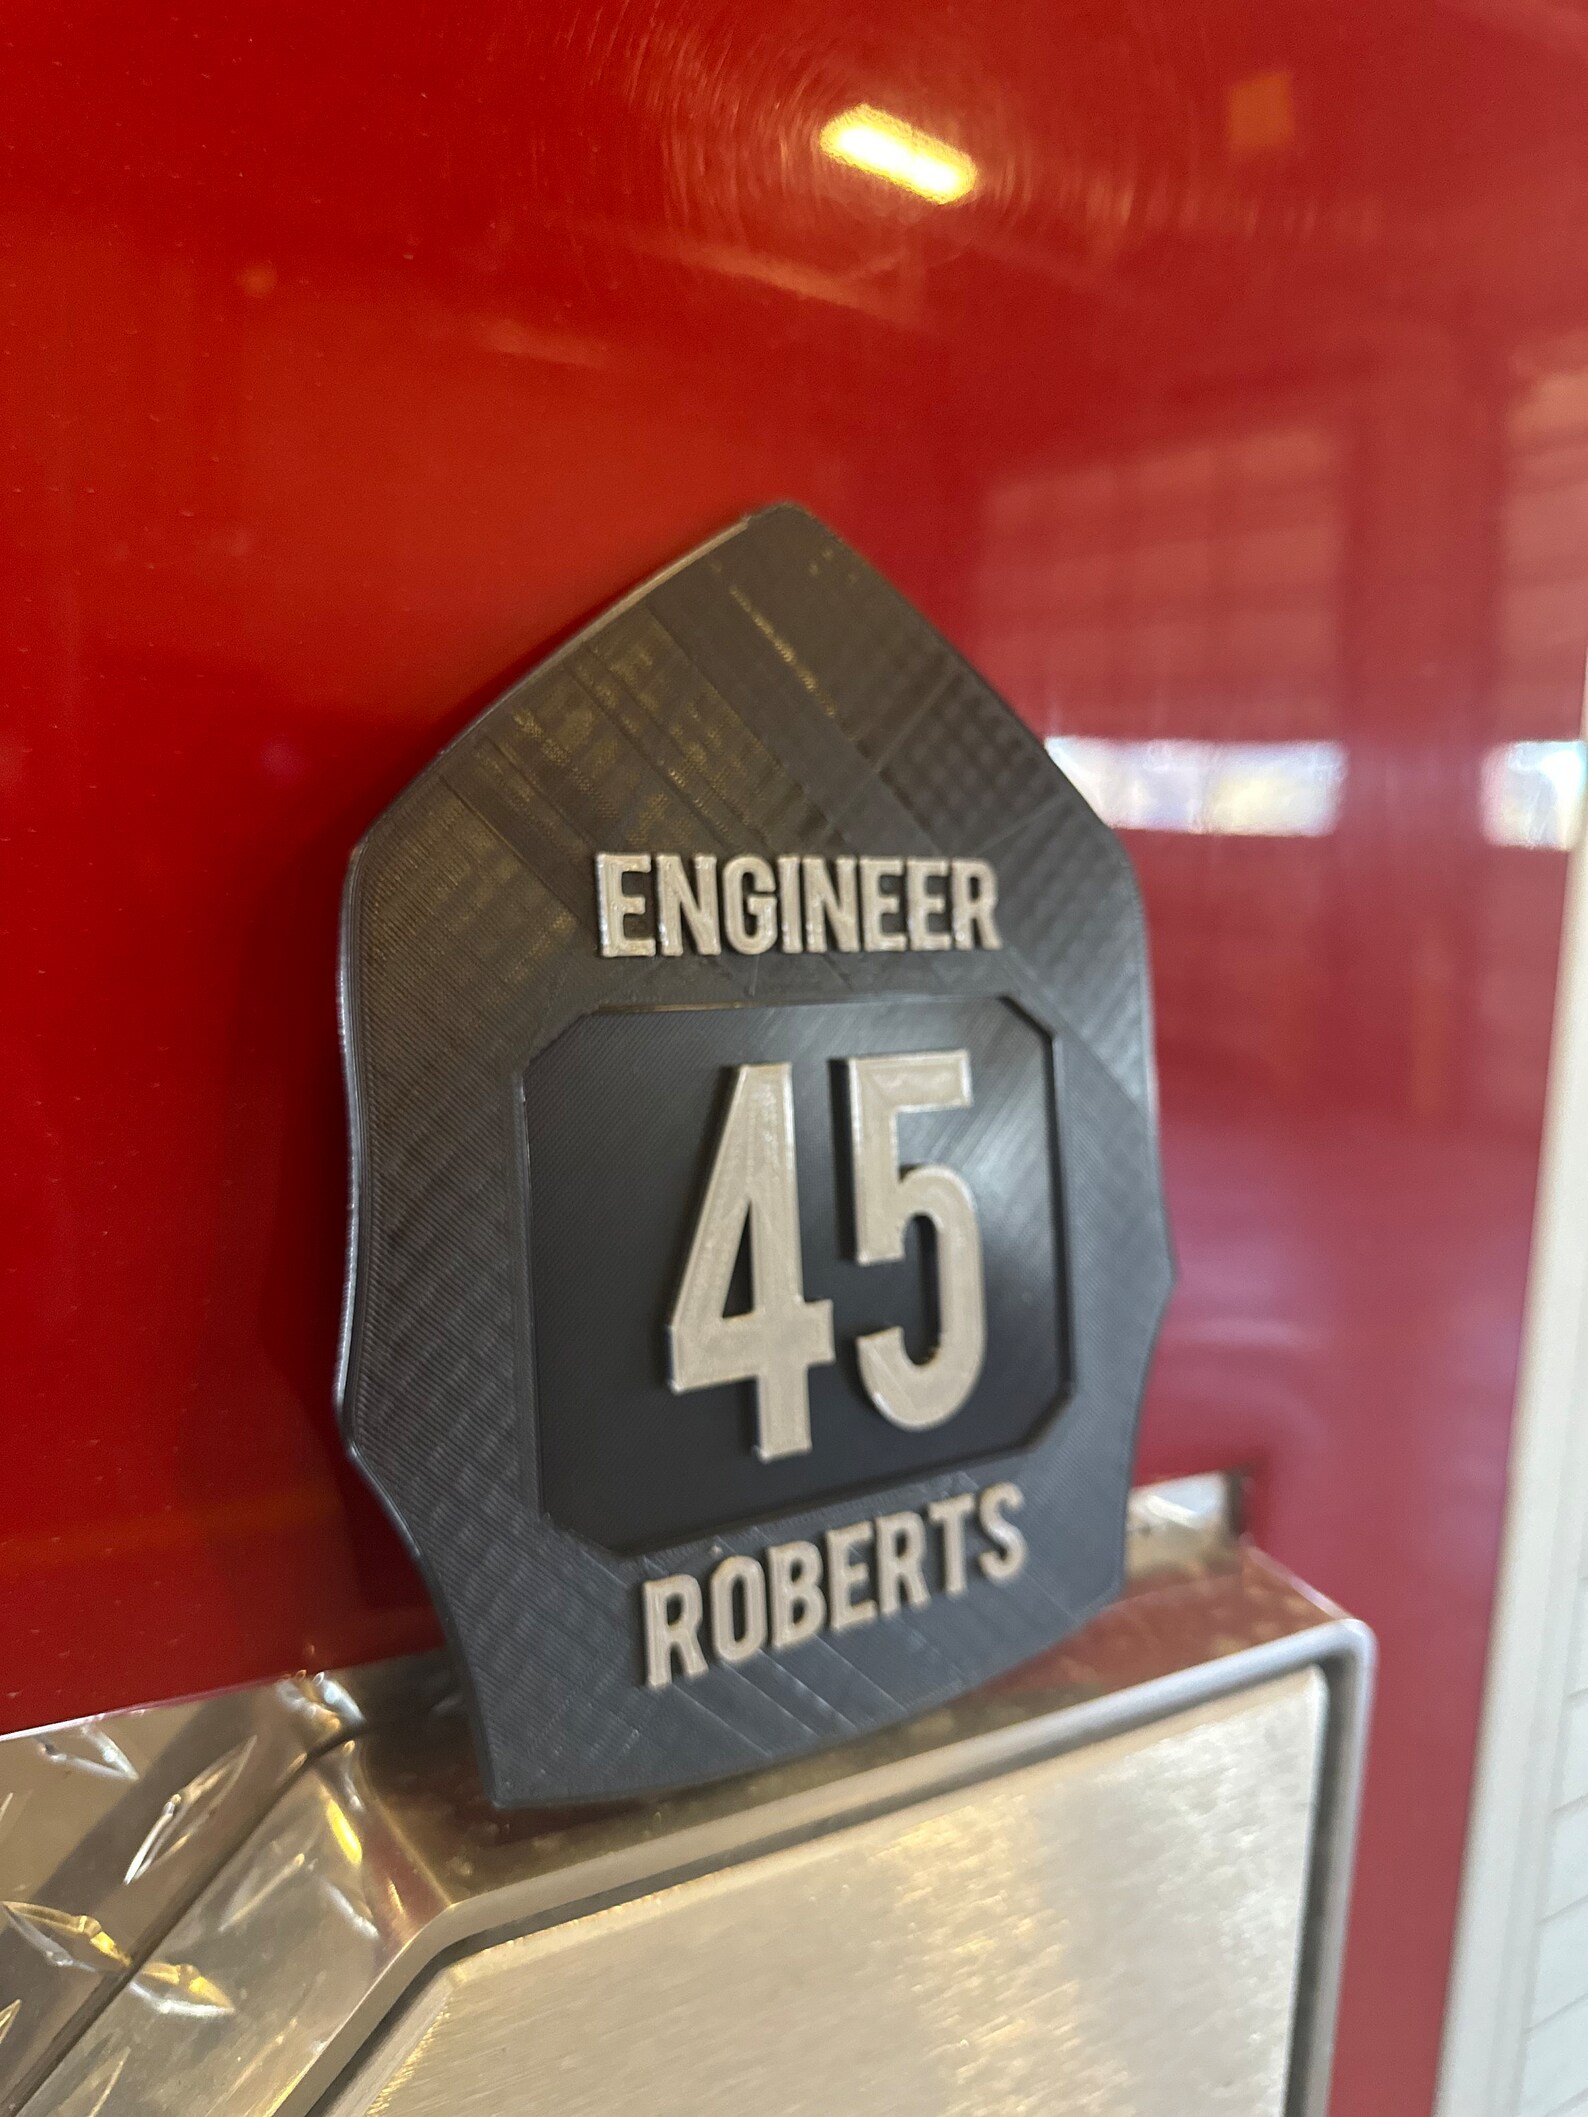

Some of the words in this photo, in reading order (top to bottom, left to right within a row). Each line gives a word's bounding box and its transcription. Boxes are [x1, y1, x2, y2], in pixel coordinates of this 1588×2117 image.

[596, 852, 1000, 957] ENGINEER
[669, 1050, 986, 1462] 45
[643, 1484, 1027, 1690] ROBERTS
